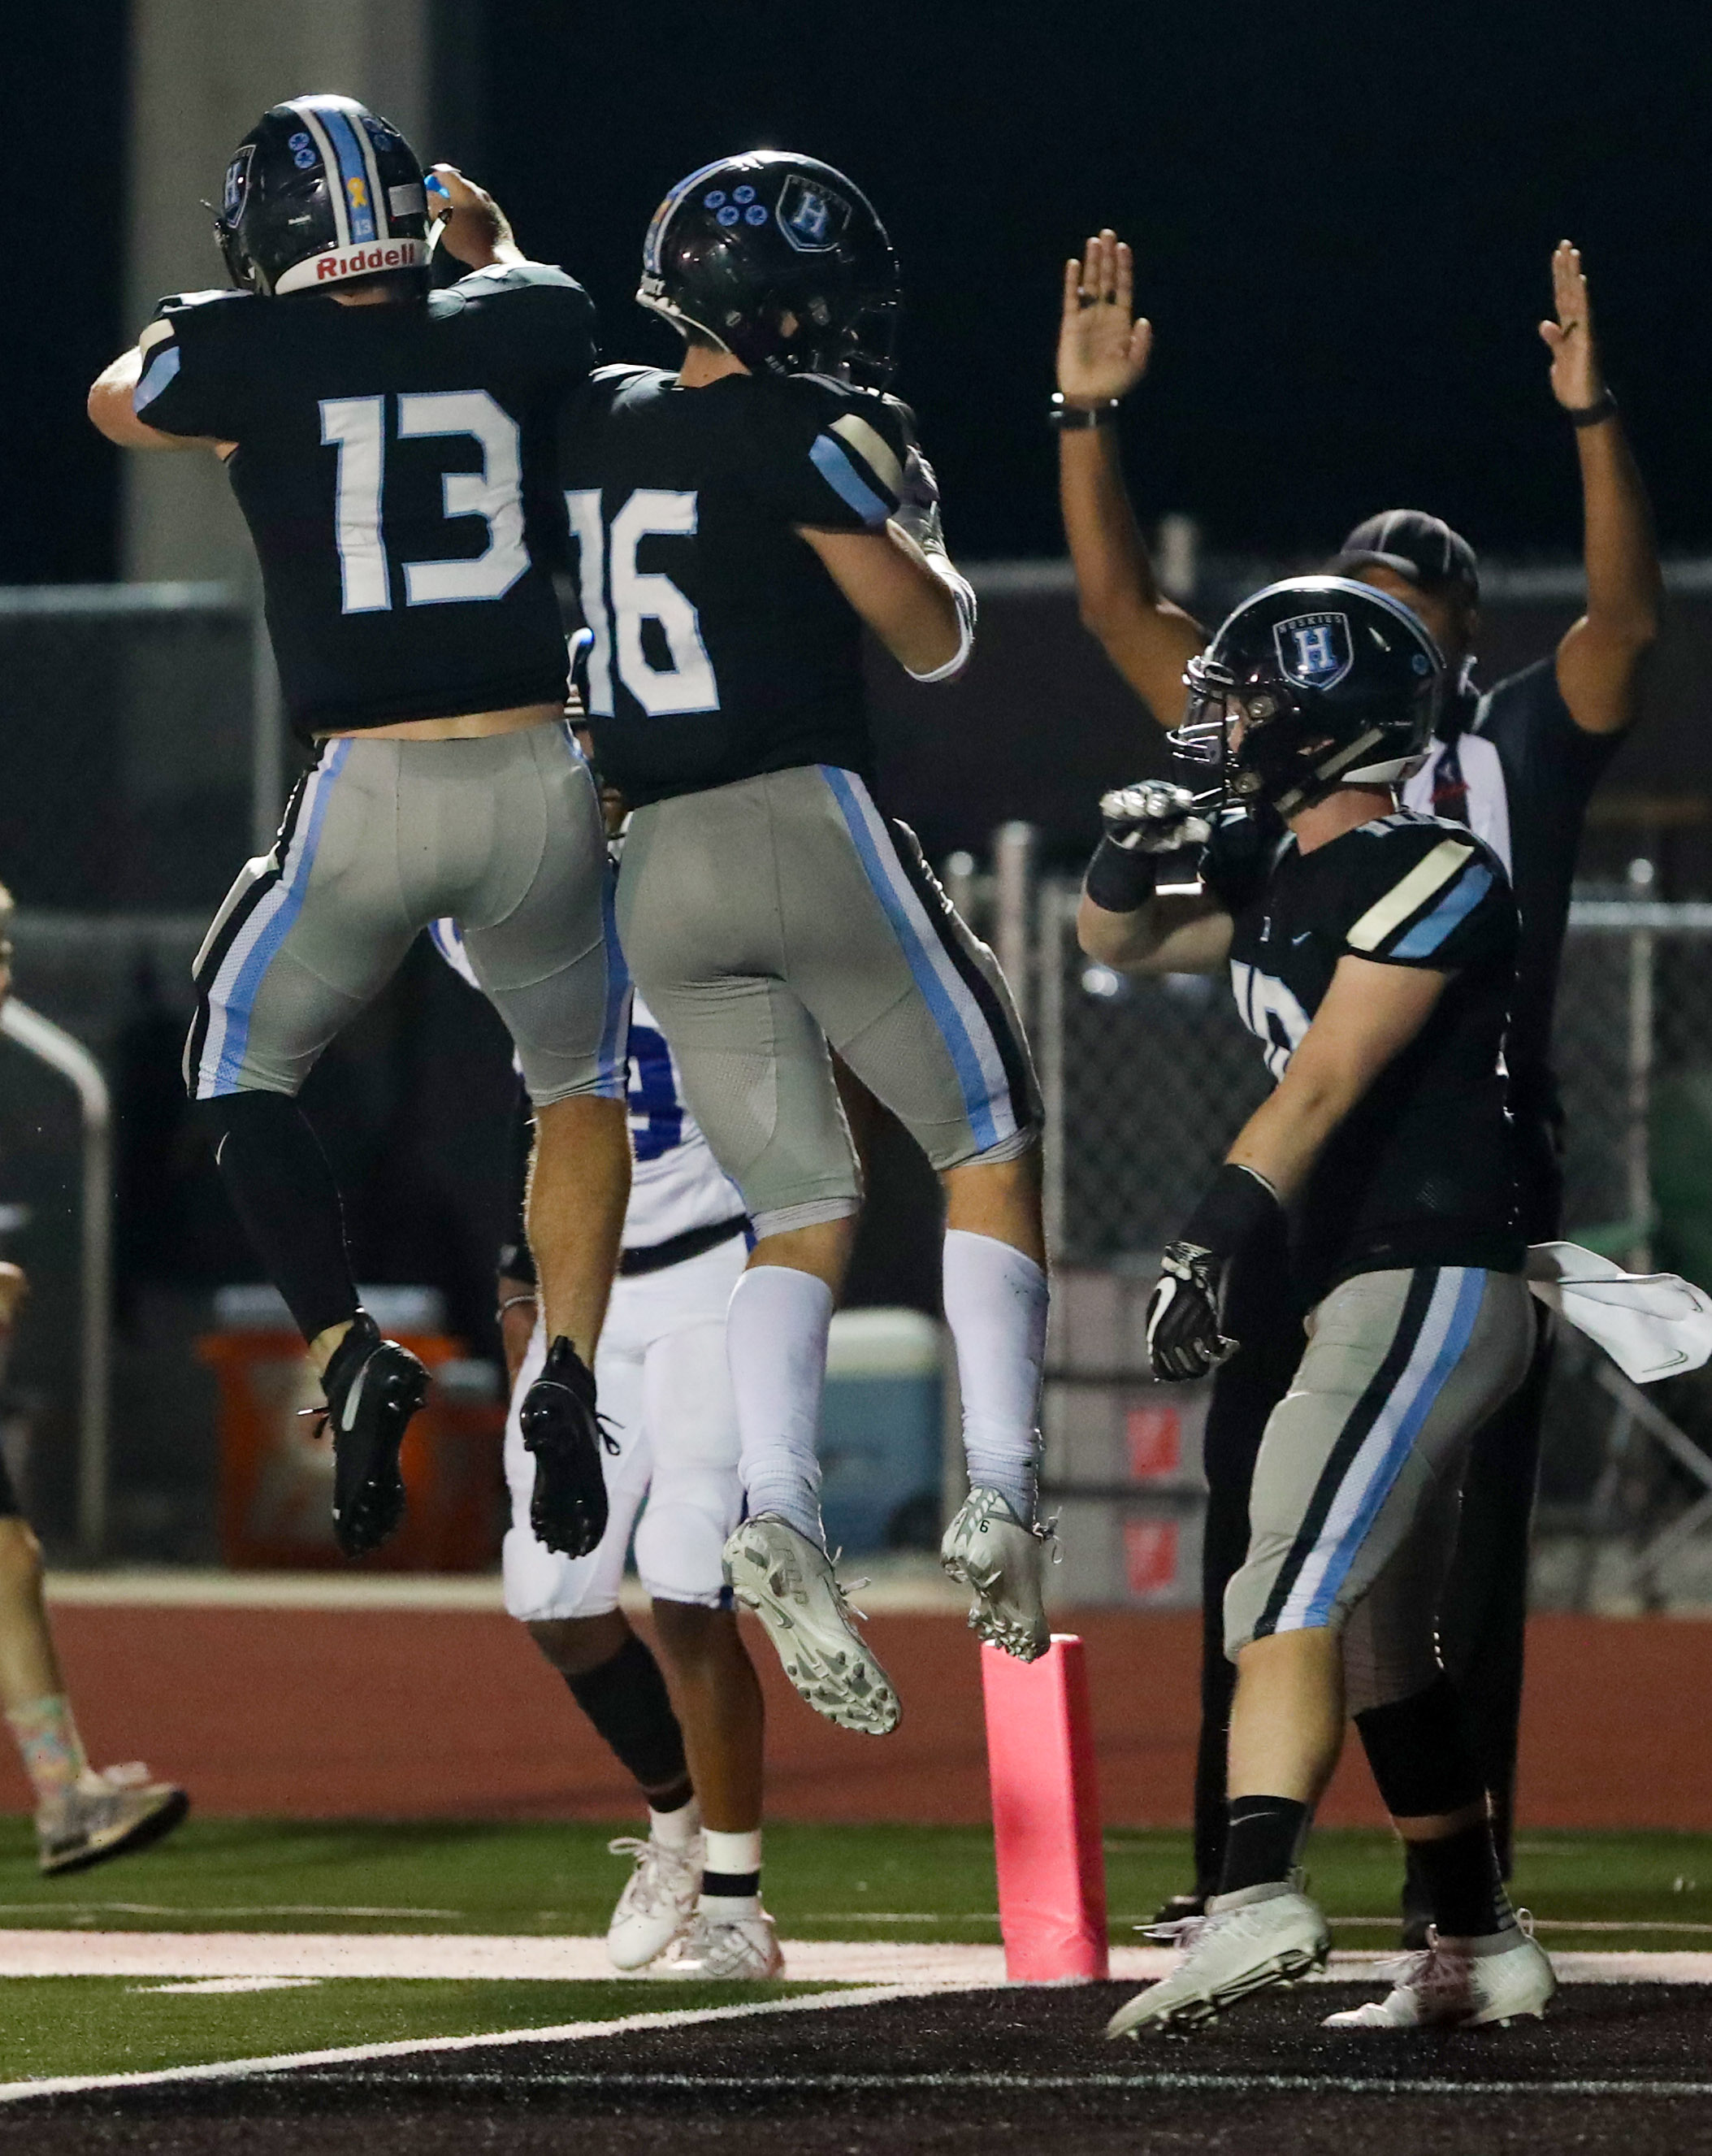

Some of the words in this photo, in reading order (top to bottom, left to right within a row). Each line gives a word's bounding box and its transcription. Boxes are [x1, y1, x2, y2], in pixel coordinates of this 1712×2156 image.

[355, 219, 373, 236] 13
[790, 192, 828, 242] H
[317, 243, 415, 280] Riddell
[318, 388, 532, 614] 13
[565, 488, 721, 718] 16
[1292, 626, 1337, 675] H
[979, 1519, 990, 1533] 6
